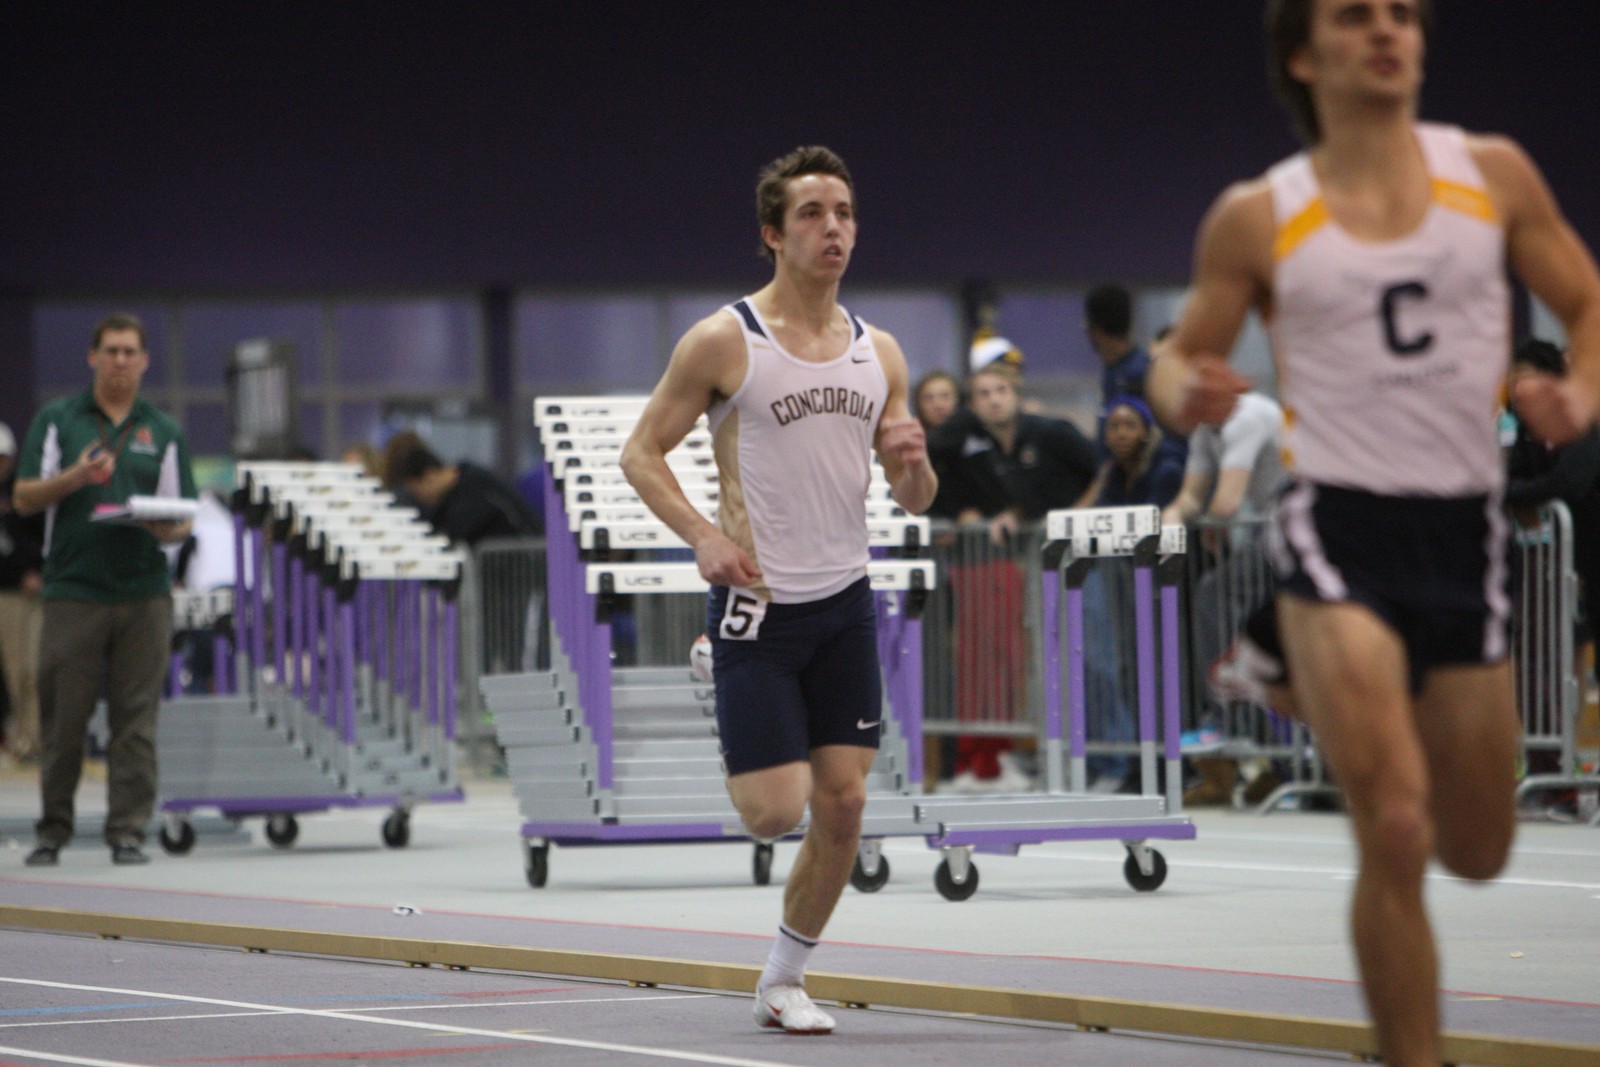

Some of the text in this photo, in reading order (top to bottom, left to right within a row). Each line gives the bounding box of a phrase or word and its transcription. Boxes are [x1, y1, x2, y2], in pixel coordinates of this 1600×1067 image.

[1380, 281, 1434, 356] C
[770, 387, 874, 426] CONCORDIA
[725, 594, 757, 637] 5
